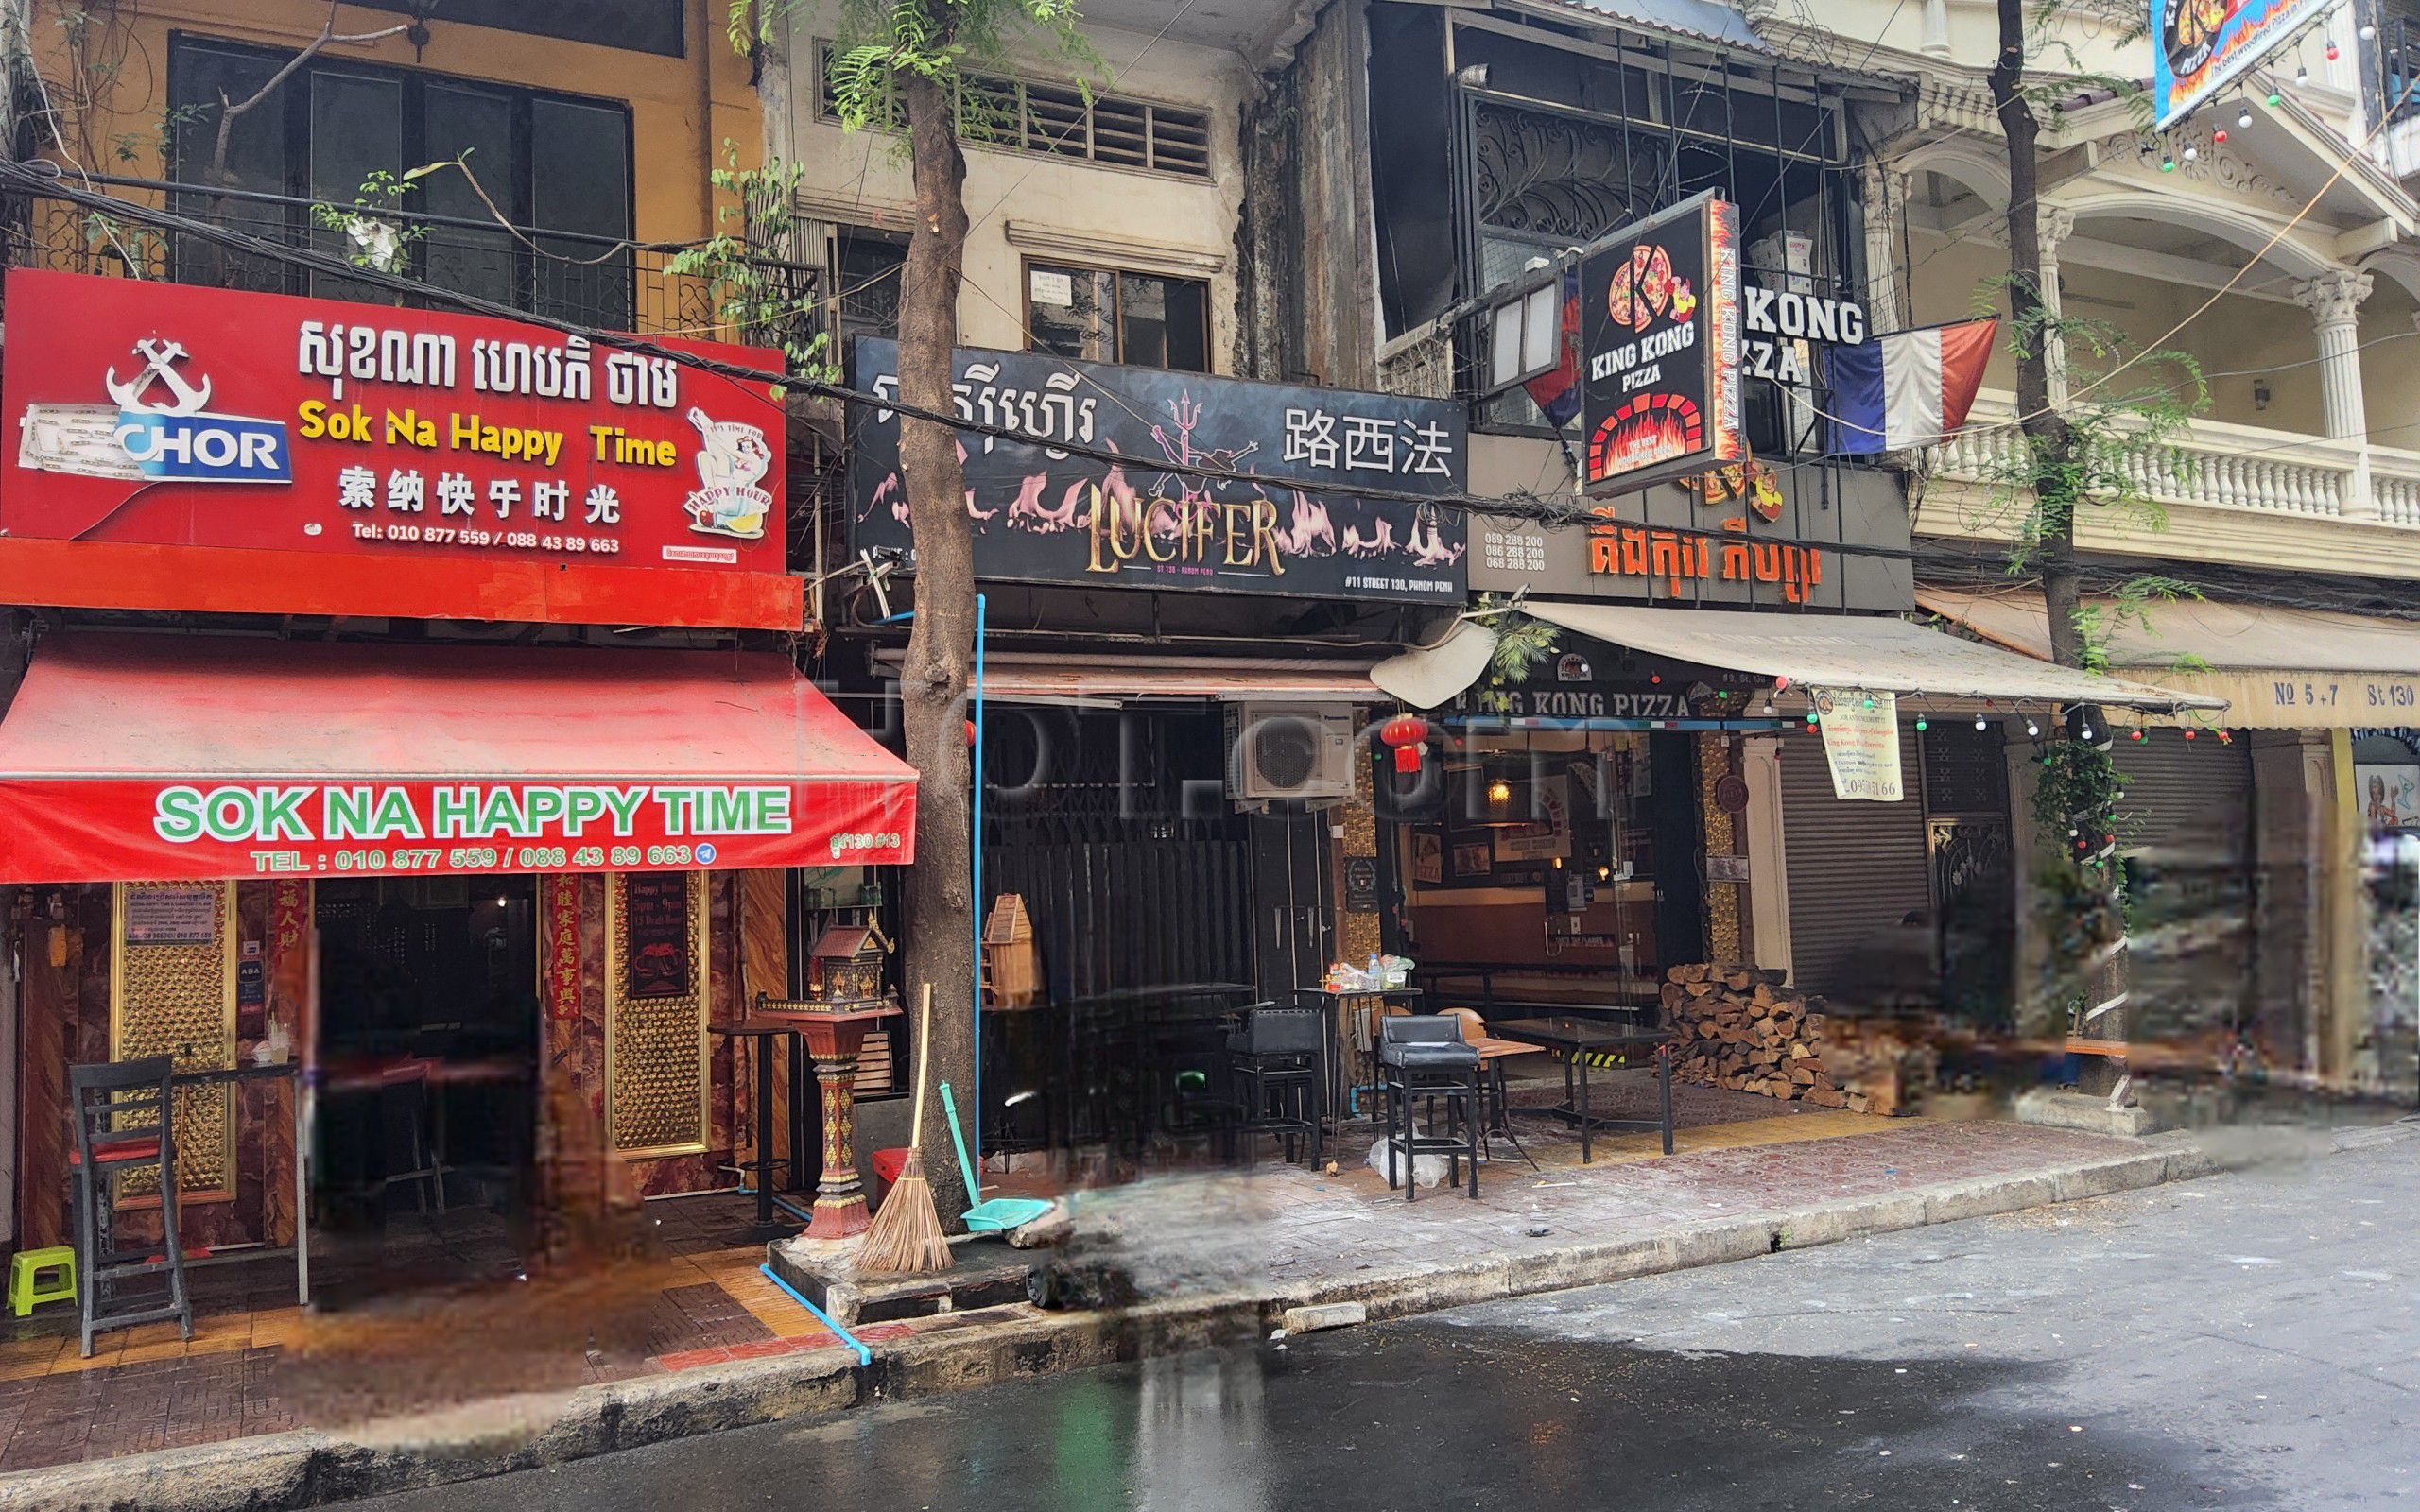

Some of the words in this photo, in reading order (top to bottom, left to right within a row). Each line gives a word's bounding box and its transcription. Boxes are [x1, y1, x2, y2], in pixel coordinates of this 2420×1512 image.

[2180, 42, 2212, 75] PIZZA
[1720, 248, 1736, 301] KING
[1744, 285, 1864, 345] KONG
[1721, 305, 1737, 366] KONG
[1591, 342, 1637, 382] KING
[1640, 321, 1695, 364] KONG
[1622, 364, 1662, 393] PIZZA
[1722, 369, 1739, 431] PIZZA
[298, 399, 372, 443] Sok
[386, 407, 438, 449] Na
[451, 412, 564, 467] Happy
[590, 424, 677, 467] Time
[1282, 408, 1453, 478] 路西法
[688, 487, 731, 512] HAPPY
[735, 486, 770, 507] HOUR
[353, 523, 383, 540] Tel:
[388, 525, 420, 542] 010
[424, 527, 456, 544] 877
[459, 529, 490, 546] 559
[507, 532, 537, 548] 088
[542, 535, 562, 551] 43
[566, 537, 586, 552] 89
[590, 538, 620, 554] 663
[1085, 483, 1286, 576] LUCIFER
[1485, 533, 1503, 545] 089
[1505, 534, 1523, 546] 288
[1525, 536, 1544, 548] 200
[1485, 544, 1504, 557] 086
[1506, 546, 1524, 558] 288
[1526, 547, 1545, 559] 200
[1486, 557, 1505, 569] 068
[1507, 558, 1525, 570] 288
[1526, 558, 1546, 571] 200
[1345, 576, 1361, 589] #11
[1362, 576, 1390, 590] STREET
[1391, 577, 1408, 592] 130,
[1409, 578, 1433, 592] PHNOM
[1434, 579, 1453, 593] PENH
[1531, 691, 1605, 716] KONG
[1613, 693, 1690, 717] PIZZA
[2367, 684, 2385, 706] St
[2389, 685, 2414, 707] 130
[153, 785, 316, 844] SOK
[323, 785, 426, 840] NA
[432, 785, 648, 839] HAPPY
[652, 785, 793, 836] TIME
[874, 833, 901, 849] #13
[251, 850, 311, 872] TEL
[335, 850, 387, 871] 010
[391, 848, 443, 869] 877
[449, 847, 497, 868] 559
[519, 847, 567, 868] 088
[572, 846, 604, 867] 43
[610, 845, 642, 866] 89
[648, 845, 692, 866] 663
